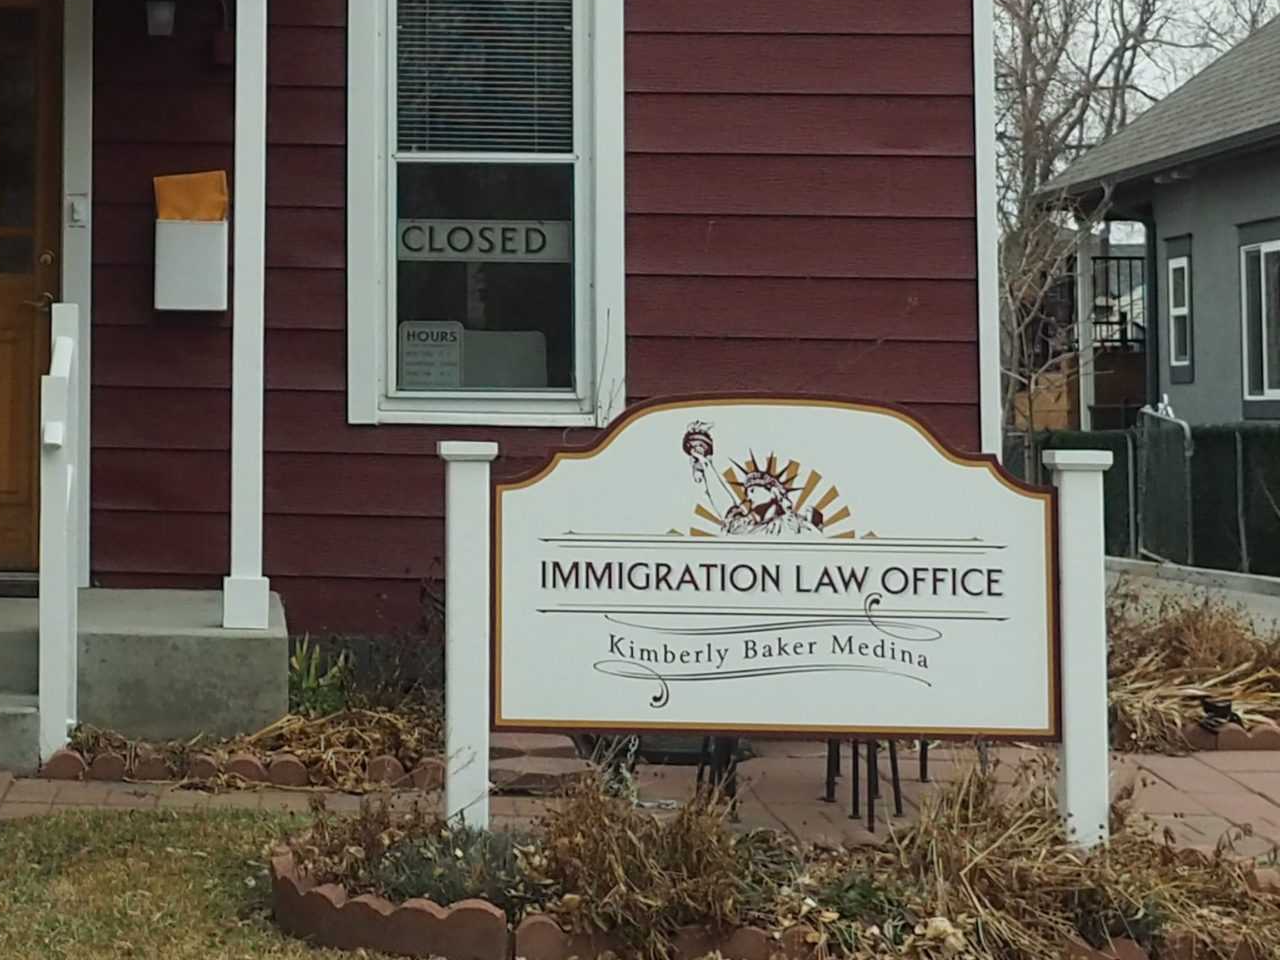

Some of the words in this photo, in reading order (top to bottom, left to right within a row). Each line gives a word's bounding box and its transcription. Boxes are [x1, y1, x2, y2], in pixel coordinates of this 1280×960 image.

[401, 225, 547, 254] CLOSED
[407, 330, 457, 342] HOURS
[539, 559, 781, 594] IMMIGRATION
[795, 565, 870, 594] LAW
[880, 566, 1004, 597] OFFICE
[608, 632, 729, 670] Kimberly
[743, 635, 817, 660] Baker
[831, 634, 930, 670] Medina
